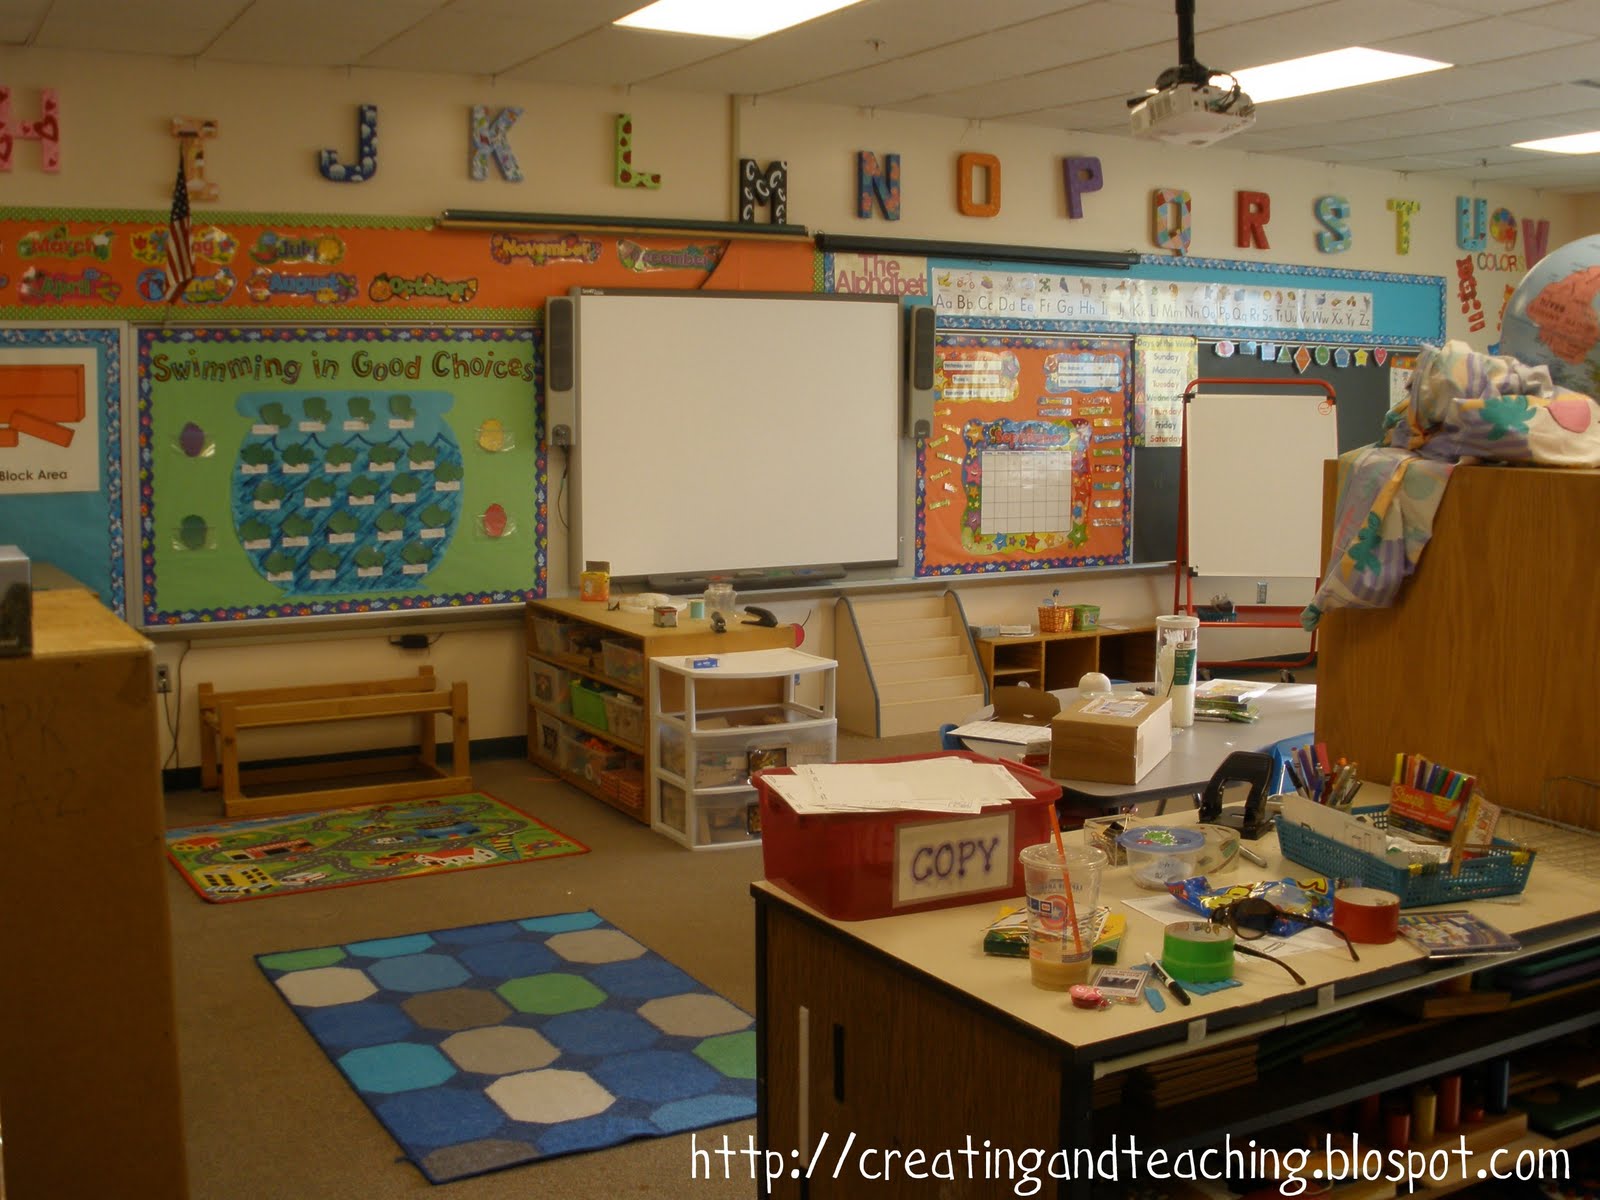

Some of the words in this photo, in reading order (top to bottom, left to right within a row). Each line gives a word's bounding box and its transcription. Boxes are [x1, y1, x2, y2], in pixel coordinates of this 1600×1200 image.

[319, 105, 377, 183] J
[470, 105, 524, 182] K
[615, 113, 662, 189] L
[739, 158, 787, 224] M
[858, 150, 900, 221] N
[956, 152, 1000, 218] O
[1063, 156, 1104, 220] P
[1150, 188, 1192, 257] Q
[1236, 189, 1271, 250] R
[1313, 195, 1352, 254] S
[1386, 197, 1421, 256] T
[1455, 195, 1488, 252] U
[1521, 218, 1550, 270] V
[32, 237, 96, 254] March
[278, 239, 319, 262] July
[502, 238, 592, 258] November
[858, 253, 900, 276] The
[1477, 252, 1526, 273] COLORS
[41, 277, 90, 300] April
[269, 273, 338, 293] August
[389, 276, 468, 296] October
[835, 270, 928, 296] Alphabet
[936, 294, 953, 309] Aa
[957, 295, 974, 310] Bb
[978, 296, 993, 311] Cc
[999, 297, 1015, 312] Dd
[1020, 298, 1034, 313] Ee
[1039, 299, 1051, 313] Ff
[1057, 298, 1074, 316] Gg
[1079, 299, 1095, 315] Hh
[1162, 304, 1182, 318] Mm
[1185, 304, 1200, 319] Nn
[1202, 305, 1215, 319] Oo
[1219, 306, 1230, 321] Pp
[1233, 307, 1247, 323] Qq
[1263, 308, 1273, 322] Ss
[1312, 311, 1329, 325] Ww
[1331, 312, 1344, 326] Xx
[1359, 313, 1370, 327] Zz
[153, 349, 301, 385] Swimming
[312, 350, 339, 379] in
[351, 350, 422, 381] Good
[432, 350, 535, 382] Choices
[1153, 353, 1179, 363] Sunday
[1152, 366, 1181, 376] Monday
[1152, 379, 1180, 389] Tuesday
[1155, 421, 1177, 431] Friday
[1150, 434, 1182, 444] Saturday
[0, 470, 33, 482] Block
[38, 470, 68, 480] Area
[911, 837, 999, 882] COPY
